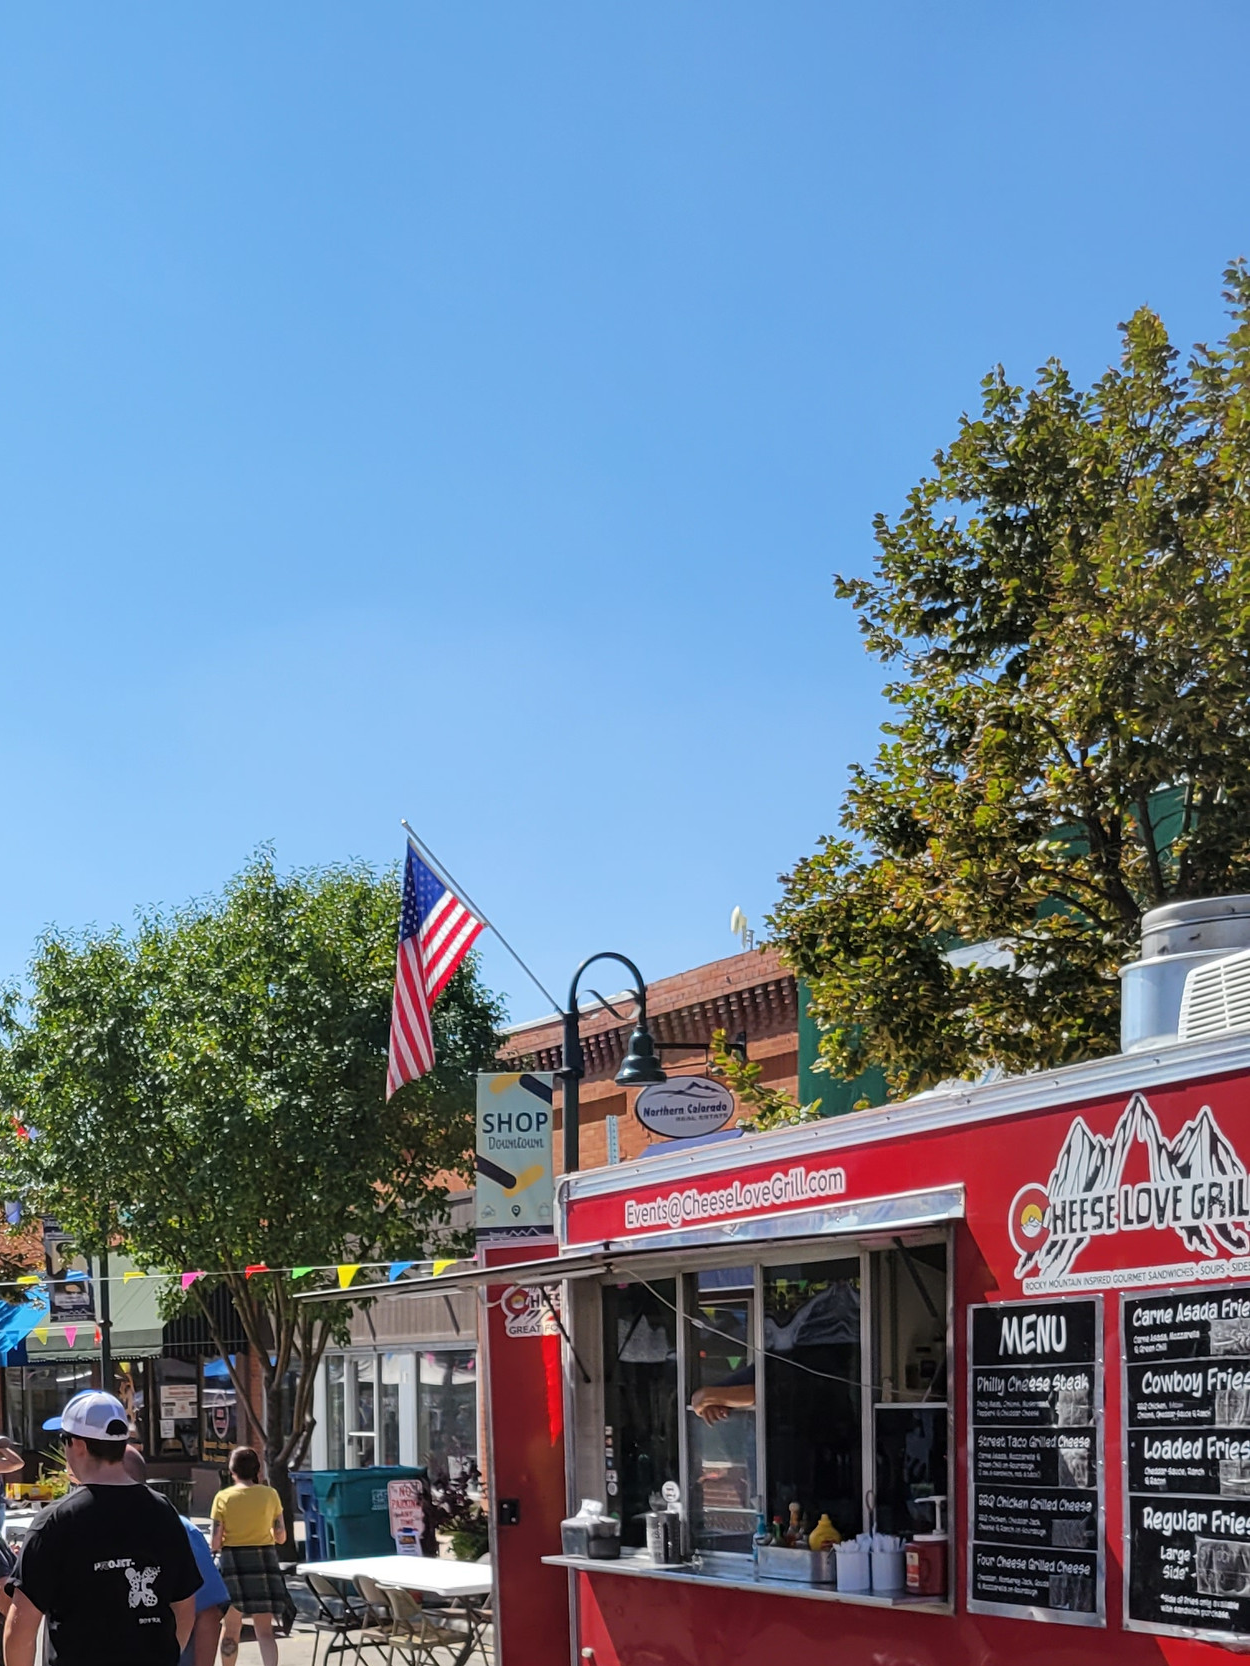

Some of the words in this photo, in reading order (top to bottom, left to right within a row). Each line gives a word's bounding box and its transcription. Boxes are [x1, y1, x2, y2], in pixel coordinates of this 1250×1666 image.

[643, 1105, 684, 1117] Northern
[687, 1102, 727, 1114] Colorado
[482, 1111, 548, 1134] SHOP
[488, 1136, 545, 1150] Downtown
[626, 1170, 843, 1225] Events@CheeseLoveGrill.com
[1123, 1186, 1182, 1225] LOVE
[1025, 1281, 1047, 1291] ROCKY
[1048, 1278, 1082, 1289] MOUNTAIN
[1084, 1275, 1111, 1286] INSPIRED
[1113, 1271, 1147, 1284] GOURMET
[1148, 1267, 1194, 1281] SANDWICHES
[1200, 1264, 1225, 1276] SOUPS
[1132, 1307, 1174, 1327] Carne
[1176, 1301, 1218, 1323] Asada
[509, 1325, 541, 1334] GREAT
[998, 1314, 1067, 1356] MENU
[976, 1376, 1005, 1396] Philly
[1008, 1375, 1050, 1392] Cheese
[1052, 1373, 1090, 1392] Steak
[1142, 1370, 1202, 1398] Cowboy
[978, 1434, 1006, 1447] Street
[1007, 1436, 1028, 1447] Taco
[1029, 1435, 1057, 1448] Grilled
[1058, 1434, 1090, 1448] Cheese
[1144, 1436, 1203, 1460] Loaded
[1206, 1436, 1250, 1460] Fries
[399, 1487, 411, 1497] NO
[978, 1494, 996, 1508] BBQ
[996, 1496, 1028, 1509] Chicken
[1030, 1498, 1058, 1512] Grilled
[1059, 1498, 1092, 1513] Cheese
[1142, 1506, 1208, 1537] Regular
[977, 1553, 996, 1567] Four
[996, 1555, 1026, 1570] Cheese
[1028, 1558, 1054, 1572] Grilled
[1056, 1560, 1090, 1575] Cheese
[1160, 1546, 1190, 1565] Large
